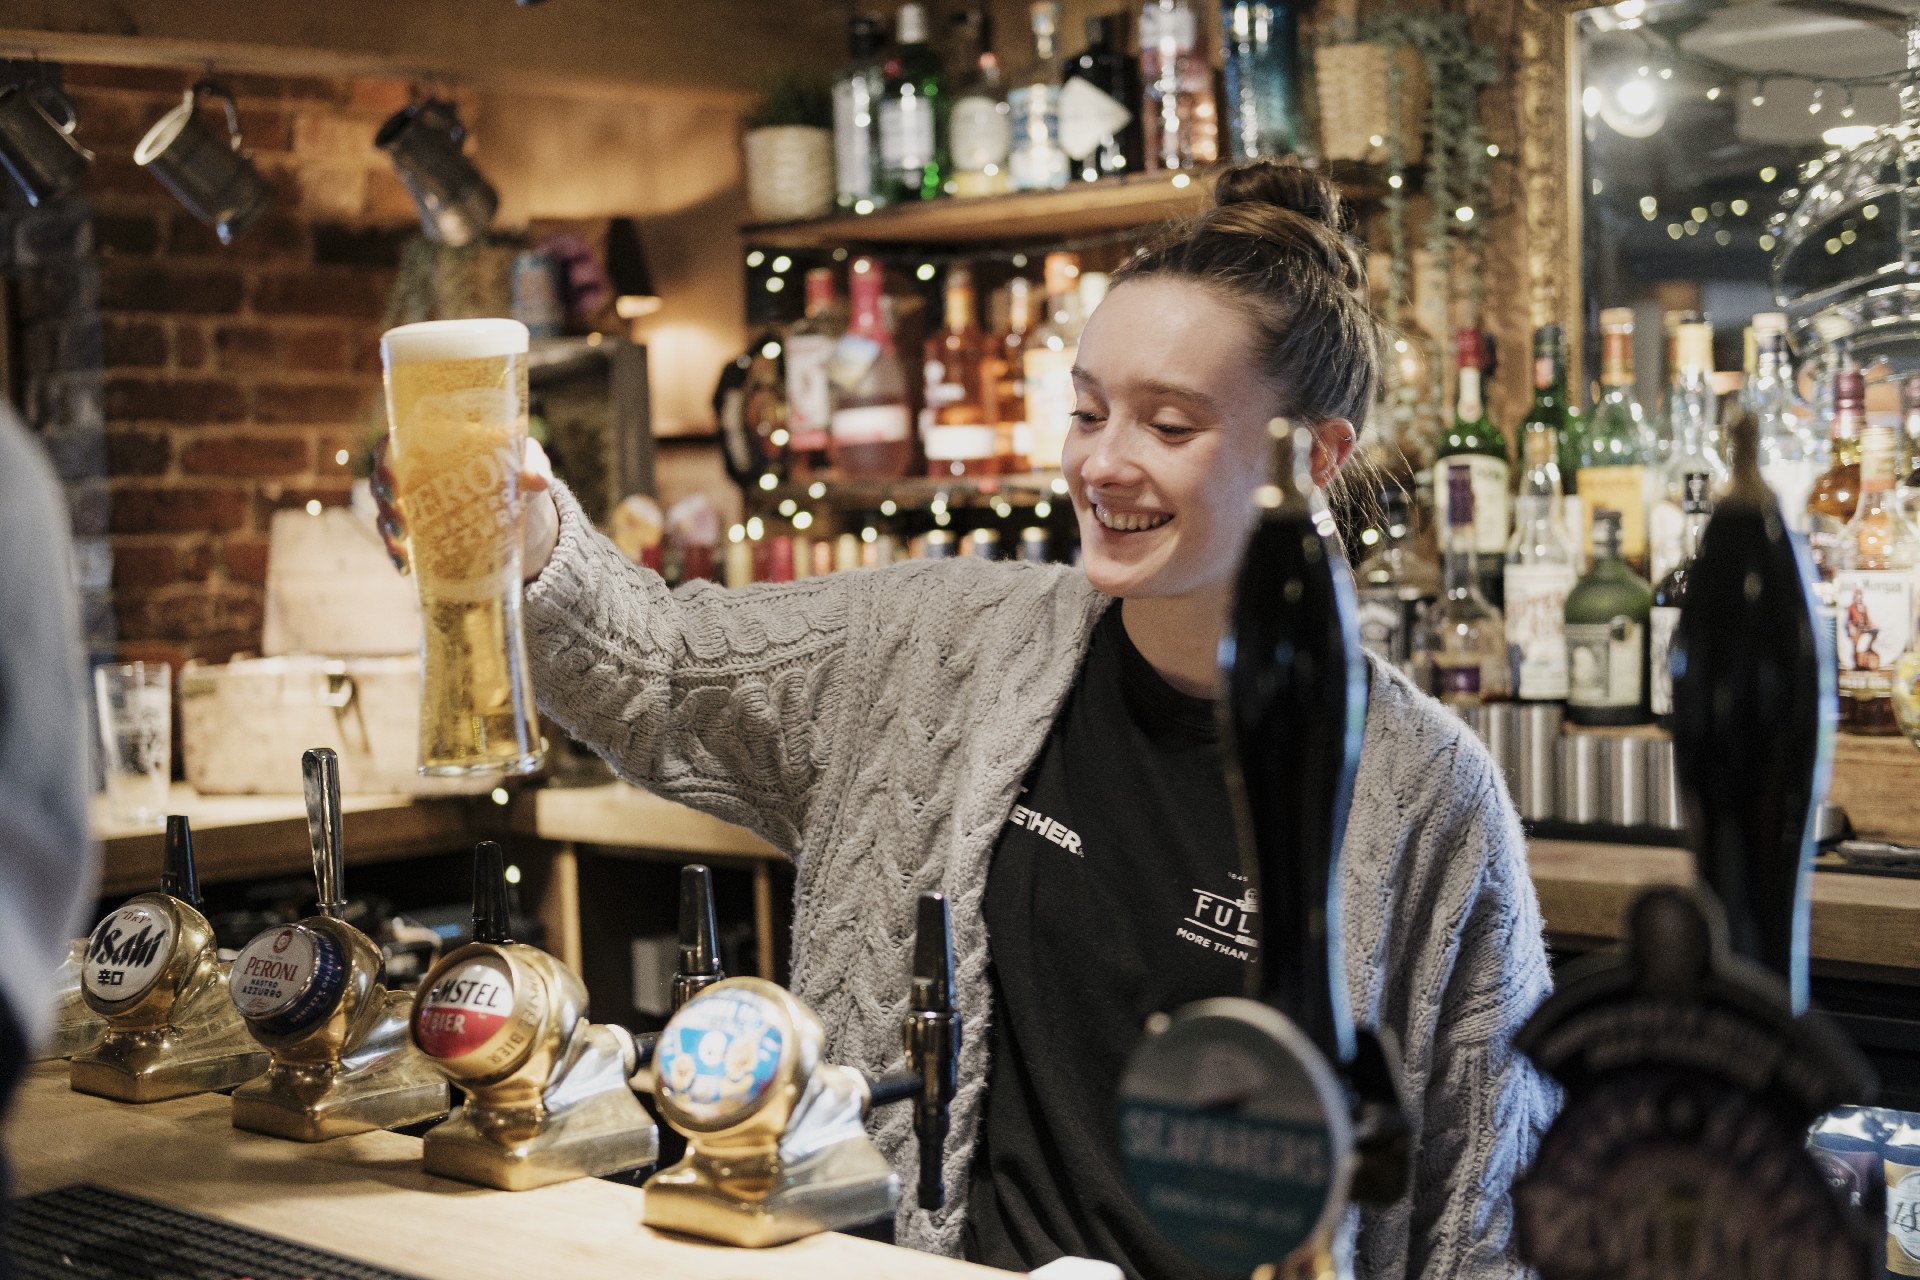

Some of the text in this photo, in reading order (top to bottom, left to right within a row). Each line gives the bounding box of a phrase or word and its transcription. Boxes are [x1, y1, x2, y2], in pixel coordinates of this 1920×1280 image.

[84, 915, 167, 968] Asahi
[1176, 927, 1249, 961] MORE THAN
[243, 956, 299, 981] PERONI
[241, 986, 283, 999] AZZURRO
[250, 979, 279, 989] NASTRO
